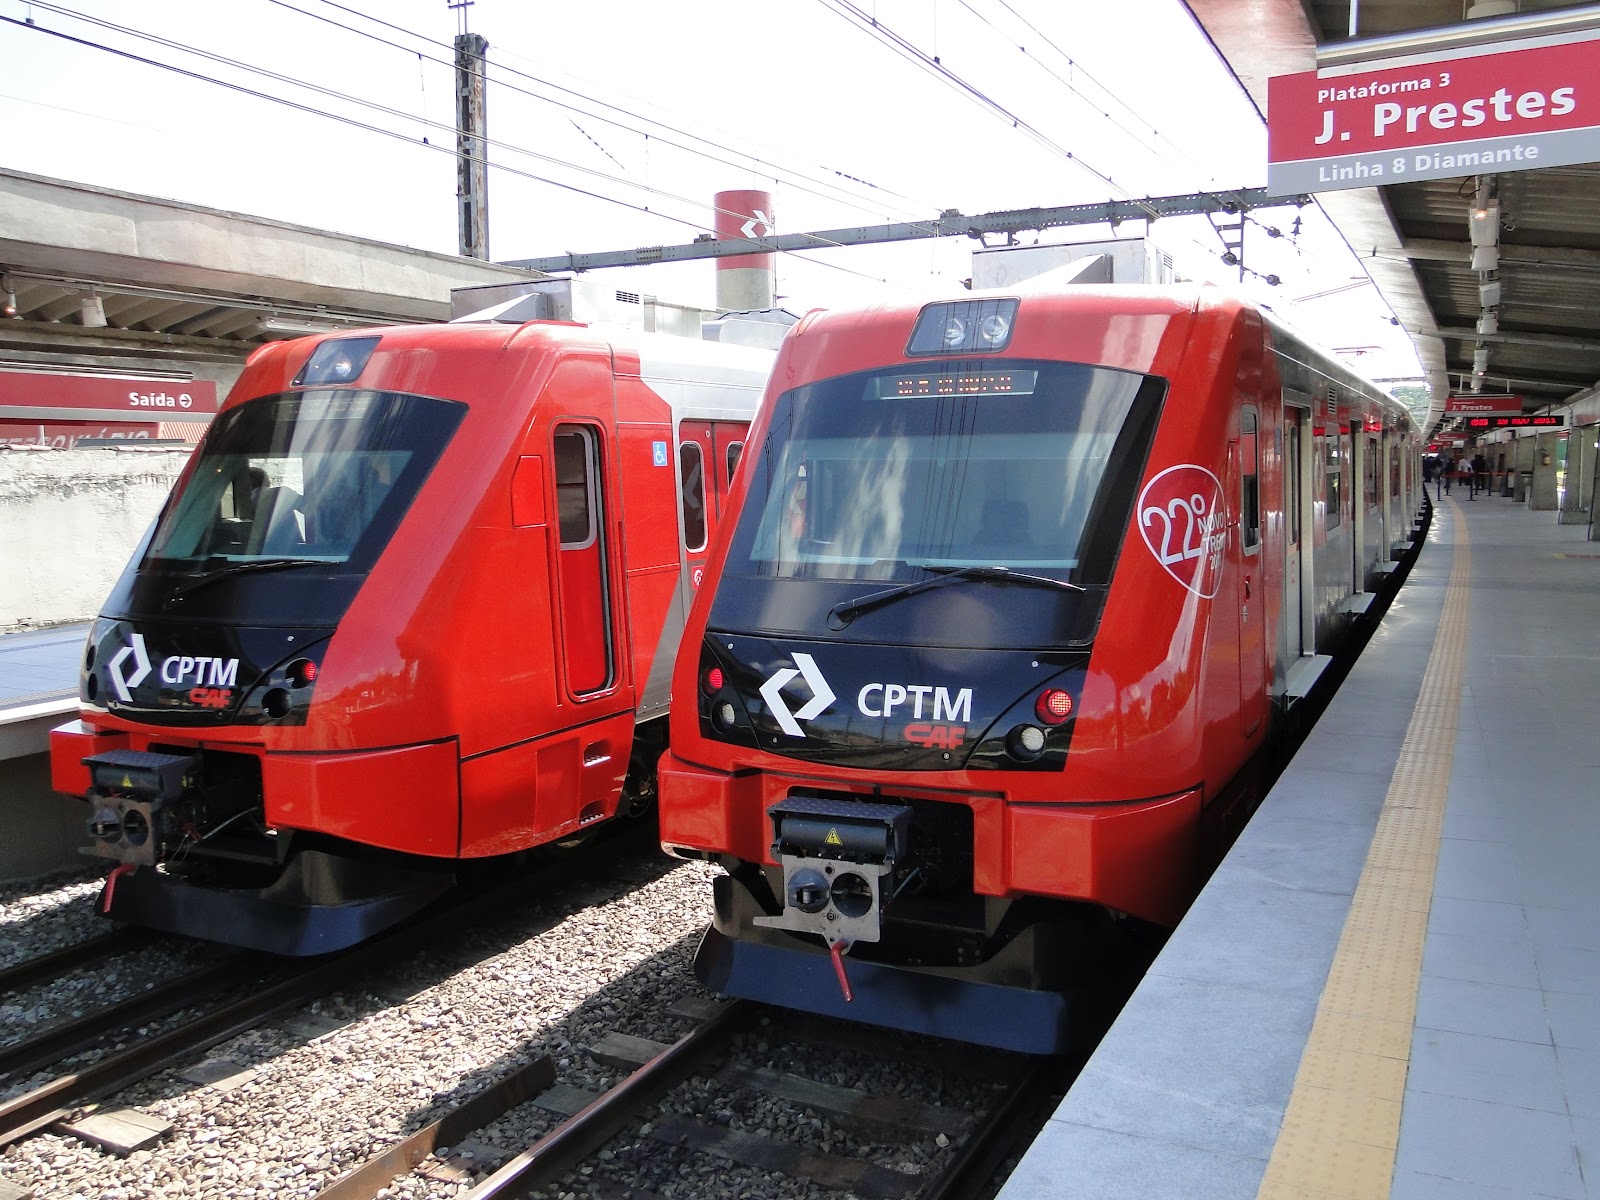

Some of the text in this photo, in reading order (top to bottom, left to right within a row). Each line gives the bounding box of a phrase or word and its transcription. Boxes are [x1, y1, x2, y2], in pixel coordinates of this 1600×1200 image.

[1317, 73, 1451, 103] Plataforma 3
[1314, 87, 1577, 145] J. Prestes
[1318, 144, 1540, 182] Linha 8 Diamante
[129, 392, 176, 407] Saída
[162, 655, 239, 686] CPTM
[189, 687, 232, 709] CAF
[857, 683, 973, 723] CPTM
[903, 724, 966, 750] CAF
